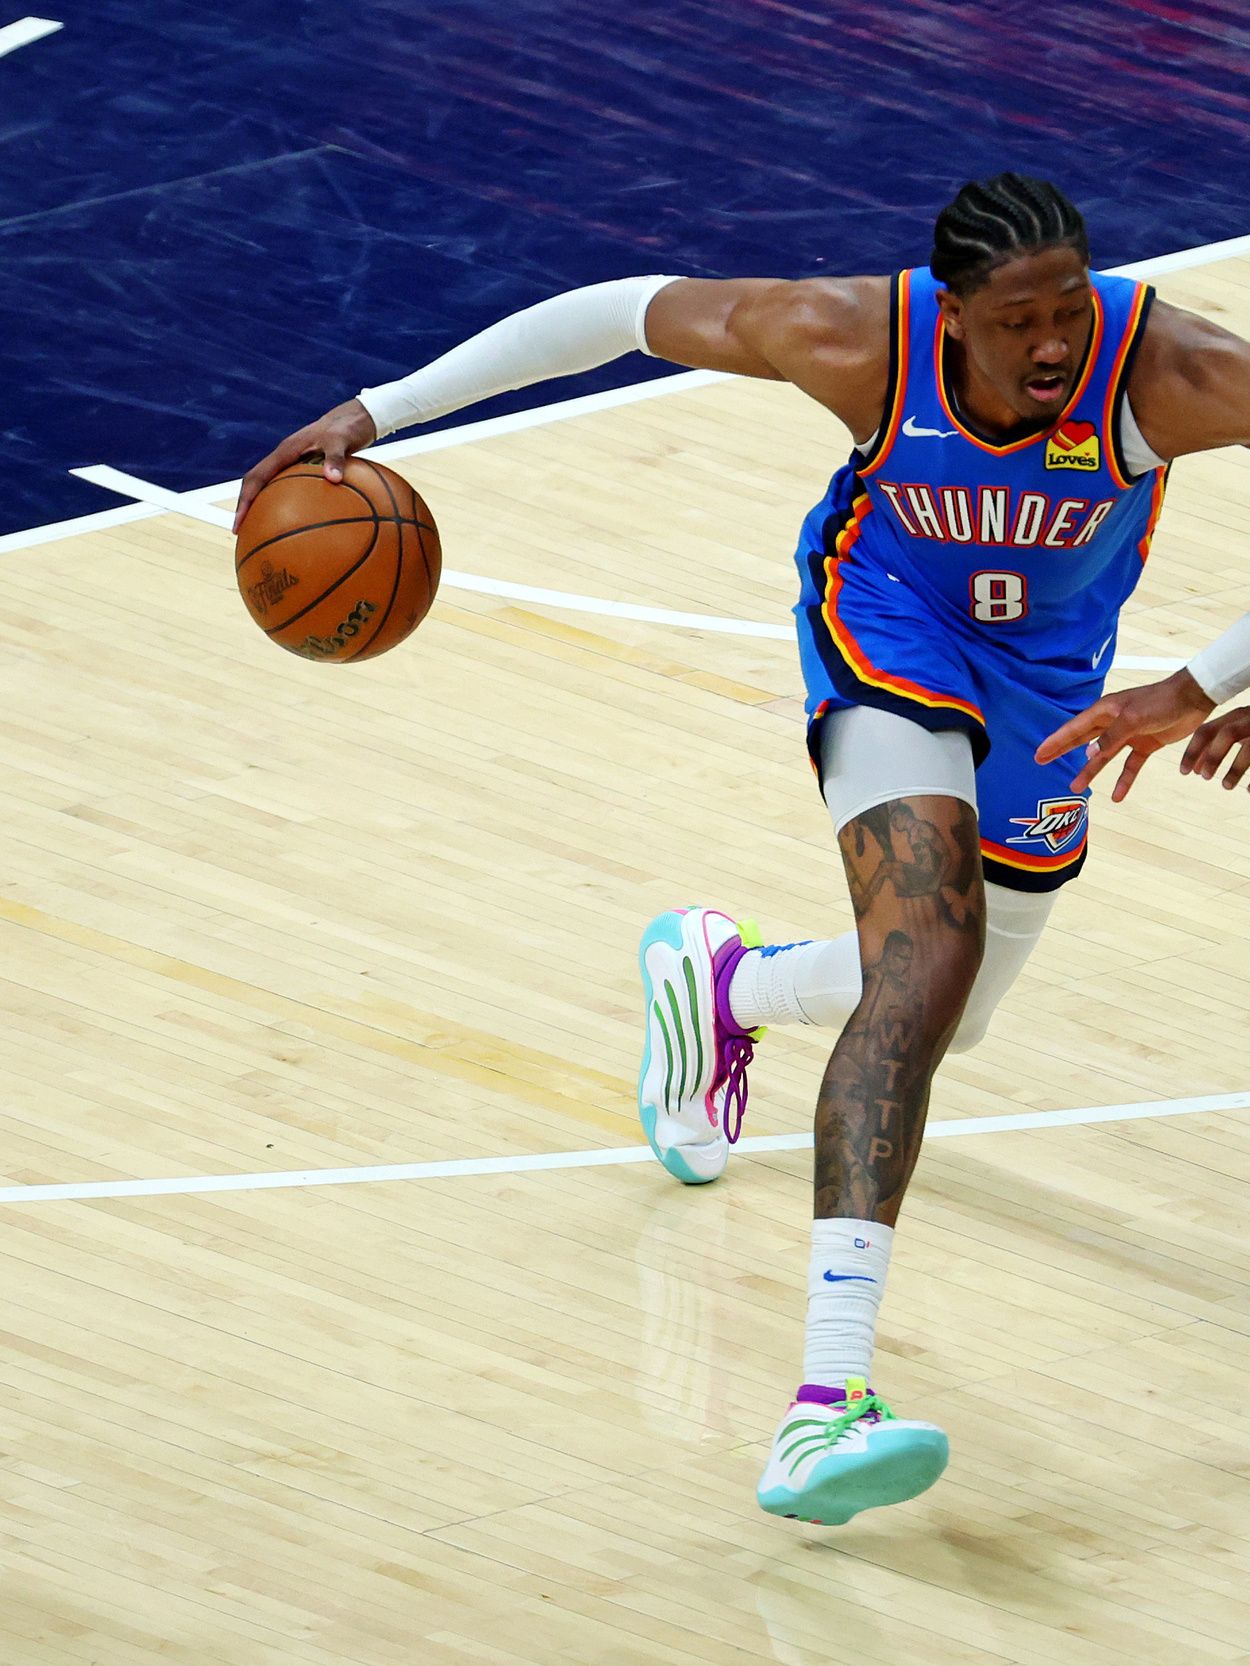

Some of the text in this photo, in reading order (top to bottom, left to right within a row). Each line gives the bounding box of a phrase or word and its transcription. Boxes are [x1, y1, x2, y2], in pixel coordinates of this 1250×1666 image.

[877, 480, 1116, 549] THUNDER
[970, 570, 1028, 623] 8
[1028, 807, 1081, 836] OKC
